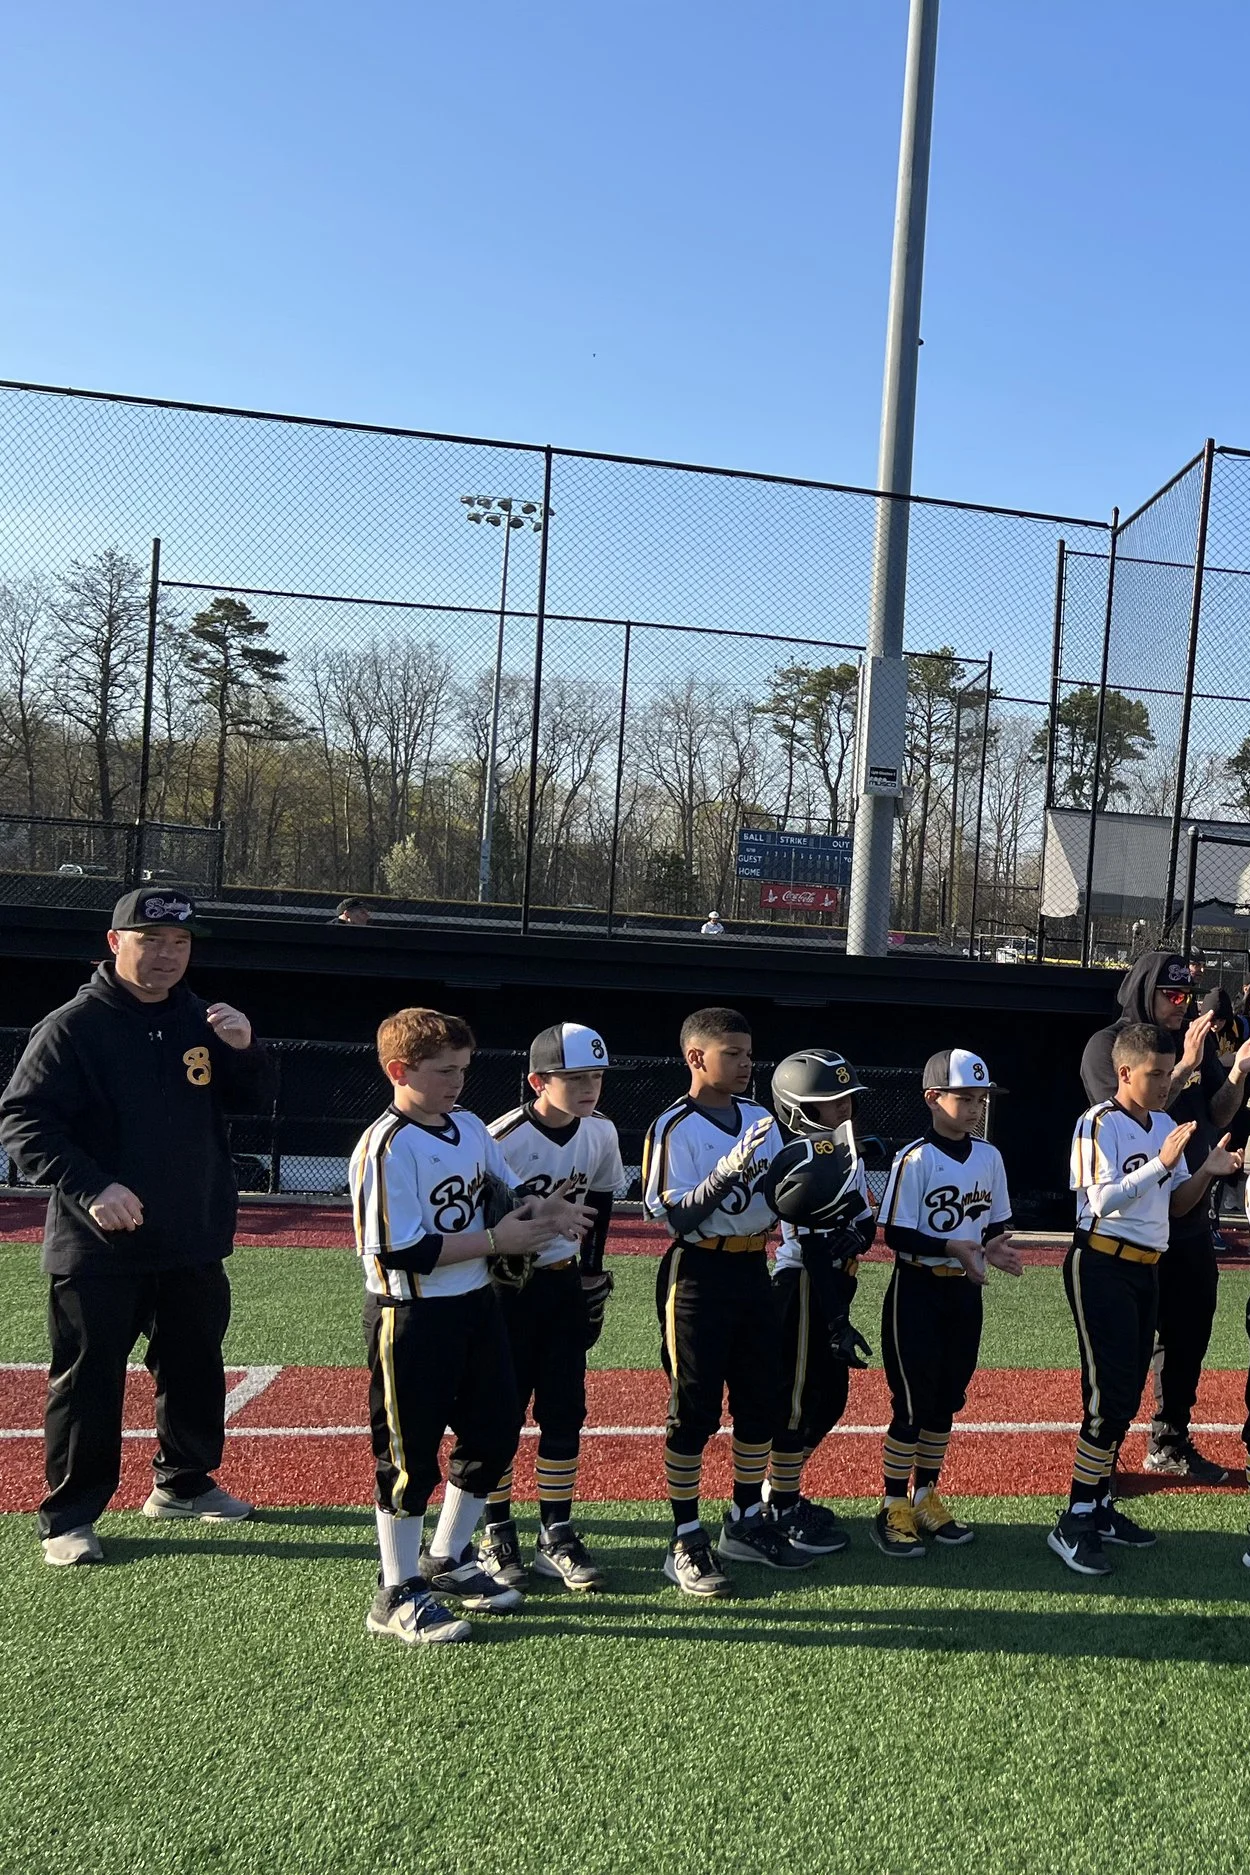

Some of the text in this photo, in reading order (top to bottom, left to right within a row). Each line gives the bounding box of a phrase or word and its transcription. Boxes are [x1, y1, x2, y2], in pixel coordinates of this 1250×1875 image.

[743, 833, 850, 848] BALL STRIKE OUT
[738, 854, 762, 863] GUEST
[738, 867, 761, 876] HOME
